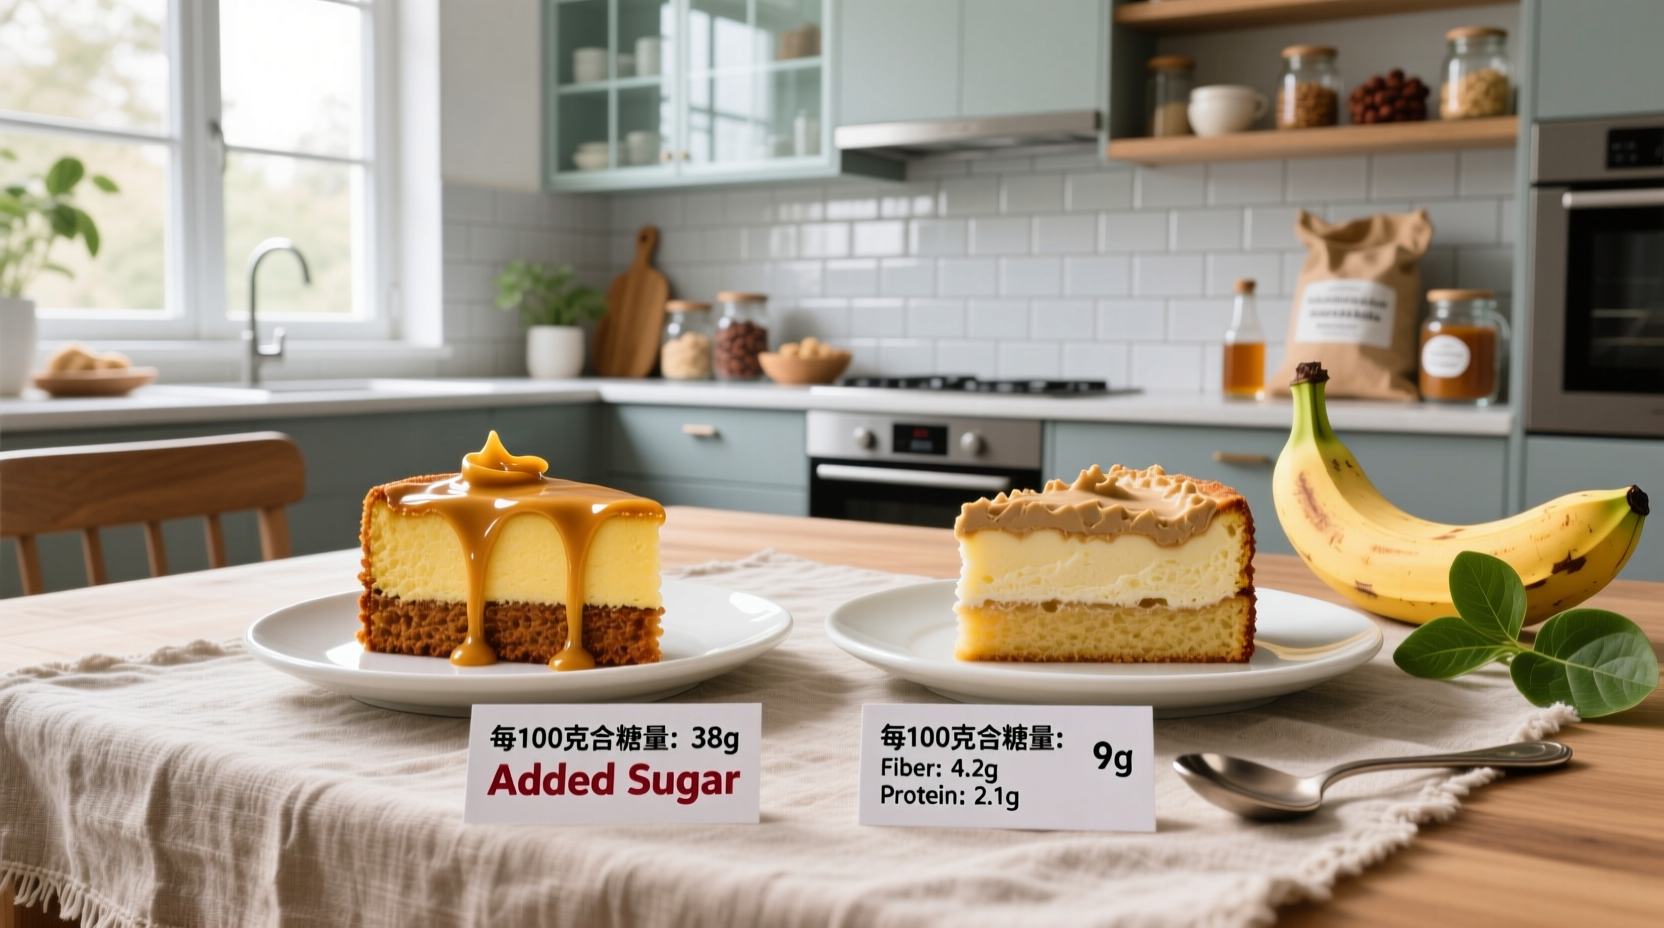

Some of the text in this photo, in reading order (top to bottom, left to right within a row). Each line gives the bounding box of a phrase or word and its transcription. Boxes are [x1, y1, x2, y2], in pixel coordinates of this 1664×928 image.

[692, 726, 740, 755] 38g
[881, 757, 998, 784] Fiber: 4.2g
[1093, 741, 1133, 778] 9g
[487, 762, 741, 805] Added Sugar
[881, 785, 1020, 812] Protein: 2.1g
